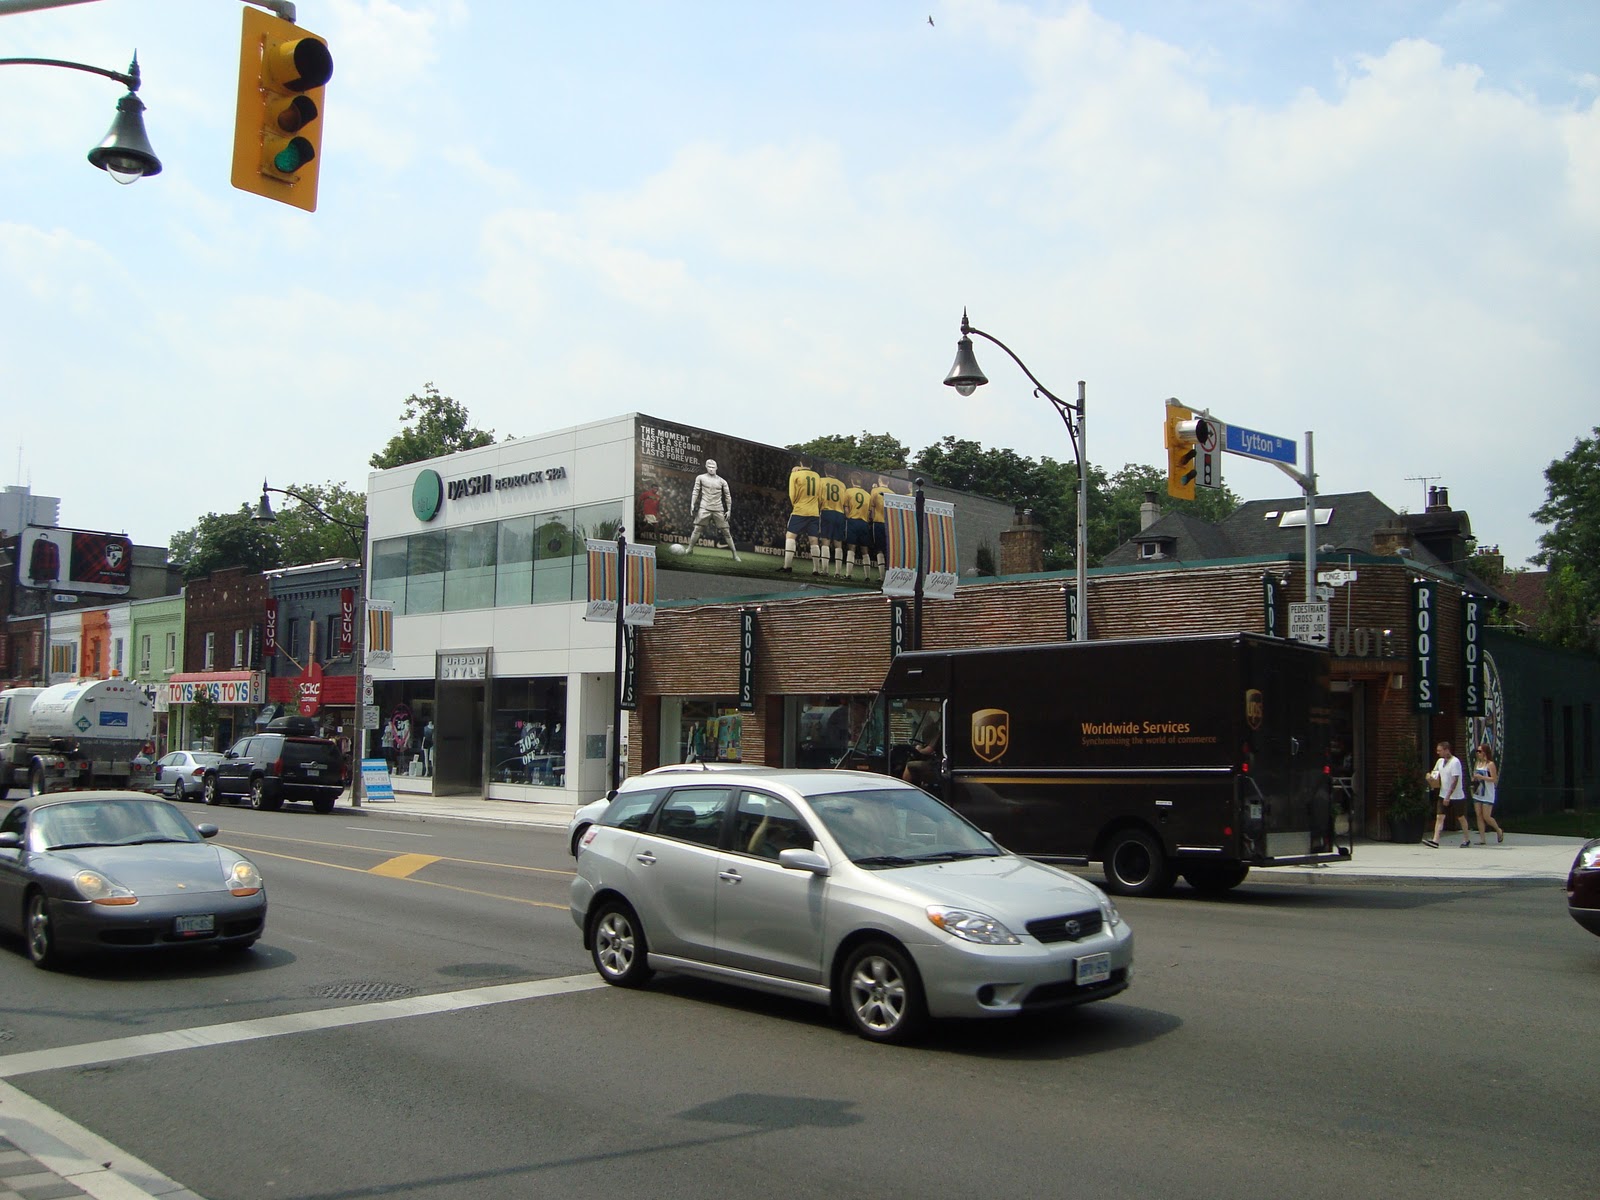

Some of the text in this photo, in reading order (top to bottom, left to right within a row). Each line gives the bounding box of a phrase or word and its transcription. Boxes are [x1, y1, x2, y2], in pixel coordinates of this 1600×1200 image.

[641, 425, 690, 443] THE MOMENT
[641, 433, 665, 444] LASTS
[673, 440, 703, 453] SECOND.
[1241, 430, 1273, 453] Lytton
[641, 440, 685, 455] THE LEGEND
[641, 447, 665, 458] LASTS
[666, 452, 701, 466] FOREVER.
[495, 471, 543, 490] BEDROCK
[545, 466, 567, 481] SPA
[805, 475, 816, 496] 11
[826, 482, 840, 502] 18
[855, 492, 864, 509] 9
[1291, 605, 1327, 614] PEDESTRIANS
[1293, 614, 1324, 623] CROSS AT
[266, 610, 276, 647] SCKC
[342, 602, 352, 643] SCKC
[1291, 624, 1326, 633] OTHER SIDE
[1294, 634, 1309, 642] ONLY
[1418, 588, 1431, 701] ROOTS
[743, 615, 752, 701] ROOTS
[1466, 602, 1477, 705] ROOTS
[169, 683, 193, 702] TOYS
[221, 682, 249, 702] TOYS
[300, 682, 320, 695] SCKC
[1081, 721, 1190, 735] Worldwide Services
[519, 731, 540, 754] 50%
[974, 724, 1007, 754] ups
